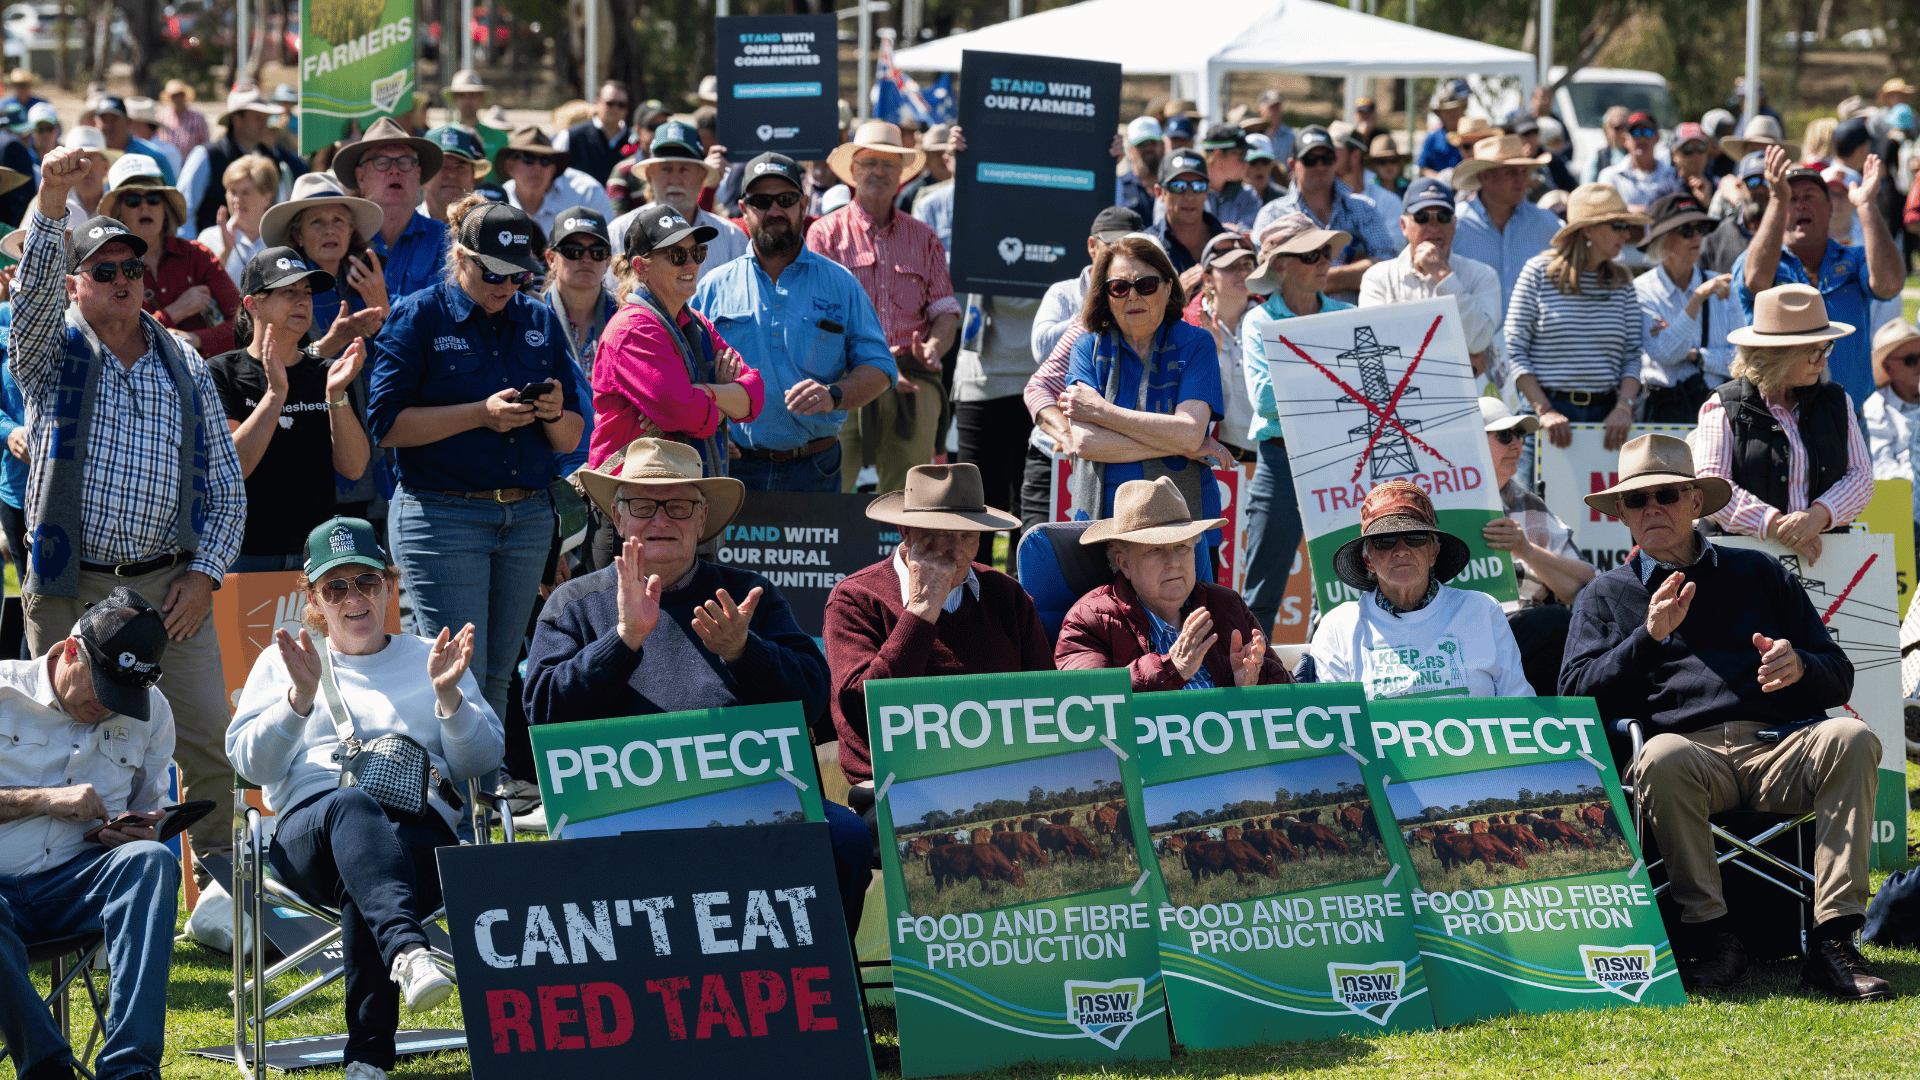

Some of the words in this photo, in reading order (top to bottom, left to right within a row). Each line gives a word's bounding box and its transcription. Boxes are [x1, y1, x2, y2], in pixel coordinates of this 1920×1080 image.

[739, 33, 781, 43] STAND
[781, 32, 815, 42] WITH
[303, 16, 412, 82] FARMERS
[744, 45, 770, 55] OUR
[771, 44, 811, 54] RURAL
[734, 54, 820, 67] COMMUNITIES
[991, 78, 1046, 94] STAND
[1048, 82, 1091, 99] WITH
[984, 95, 1019, 110] OUR
[1020, 98, 1095, 117] FARMERS
[433, 343, 469, 352] WESTERN
[1311, 466, 1482, 513] TRAGRID
[329, 533, 353, 543] GROW
[725, 526, 780, 542] TAND
[784, 527, 839, 544] WITH
[331, 545, 355, 554] THING
[718, 547, 761, 563] OUR
[764, 549, 830, 566] RURAL
[1379, 649, 1420, 665] KEEP
[879, 694, 1126, 752] PROTECT
[1136, 705, 1361, 758] PROTECT
[1372, 717, 1596, 758] PROTECT
[546, 727, 800, 794] PROTECT
[1411, 889, 1495, 915] FOOD
[1503, 885, 1563, 910] AND
[1567, 884, 1651, 906] FIBRE
[1158, 902, 1243, 931] FOOD
[1252, 897, 1315, 925] AND
[1319, 893, 1405, 919] FIBRE
[1442, 907, 1634, 937] PRODUCTION
[474, 895, 675, 969] CAN'T
[692, 886, 817, 955] EAT
[897, 912, 984, 944] FOOD
[992, 908, 1057, 938] AND
[1064, 902, 1150, 932] FIBRE
[1189, 919, 1385, 955] PRODUCTION
[926, 931, 1127, 970] PRODUCTION
[1594, 956, 1643, 972] nsw
[1341, 973, 1393, 993] nsw
[1597, 972, 1649, 982] FARMERS
[1078, 992, 1130, 1013] nsw
[1345, 991, 1398, 1003] FARMERS
[486, 982, 635, 1054] RED
[646, 966, 838, 1041] TAPE
[1079, 1011, 1134, 1025] FARMERS
